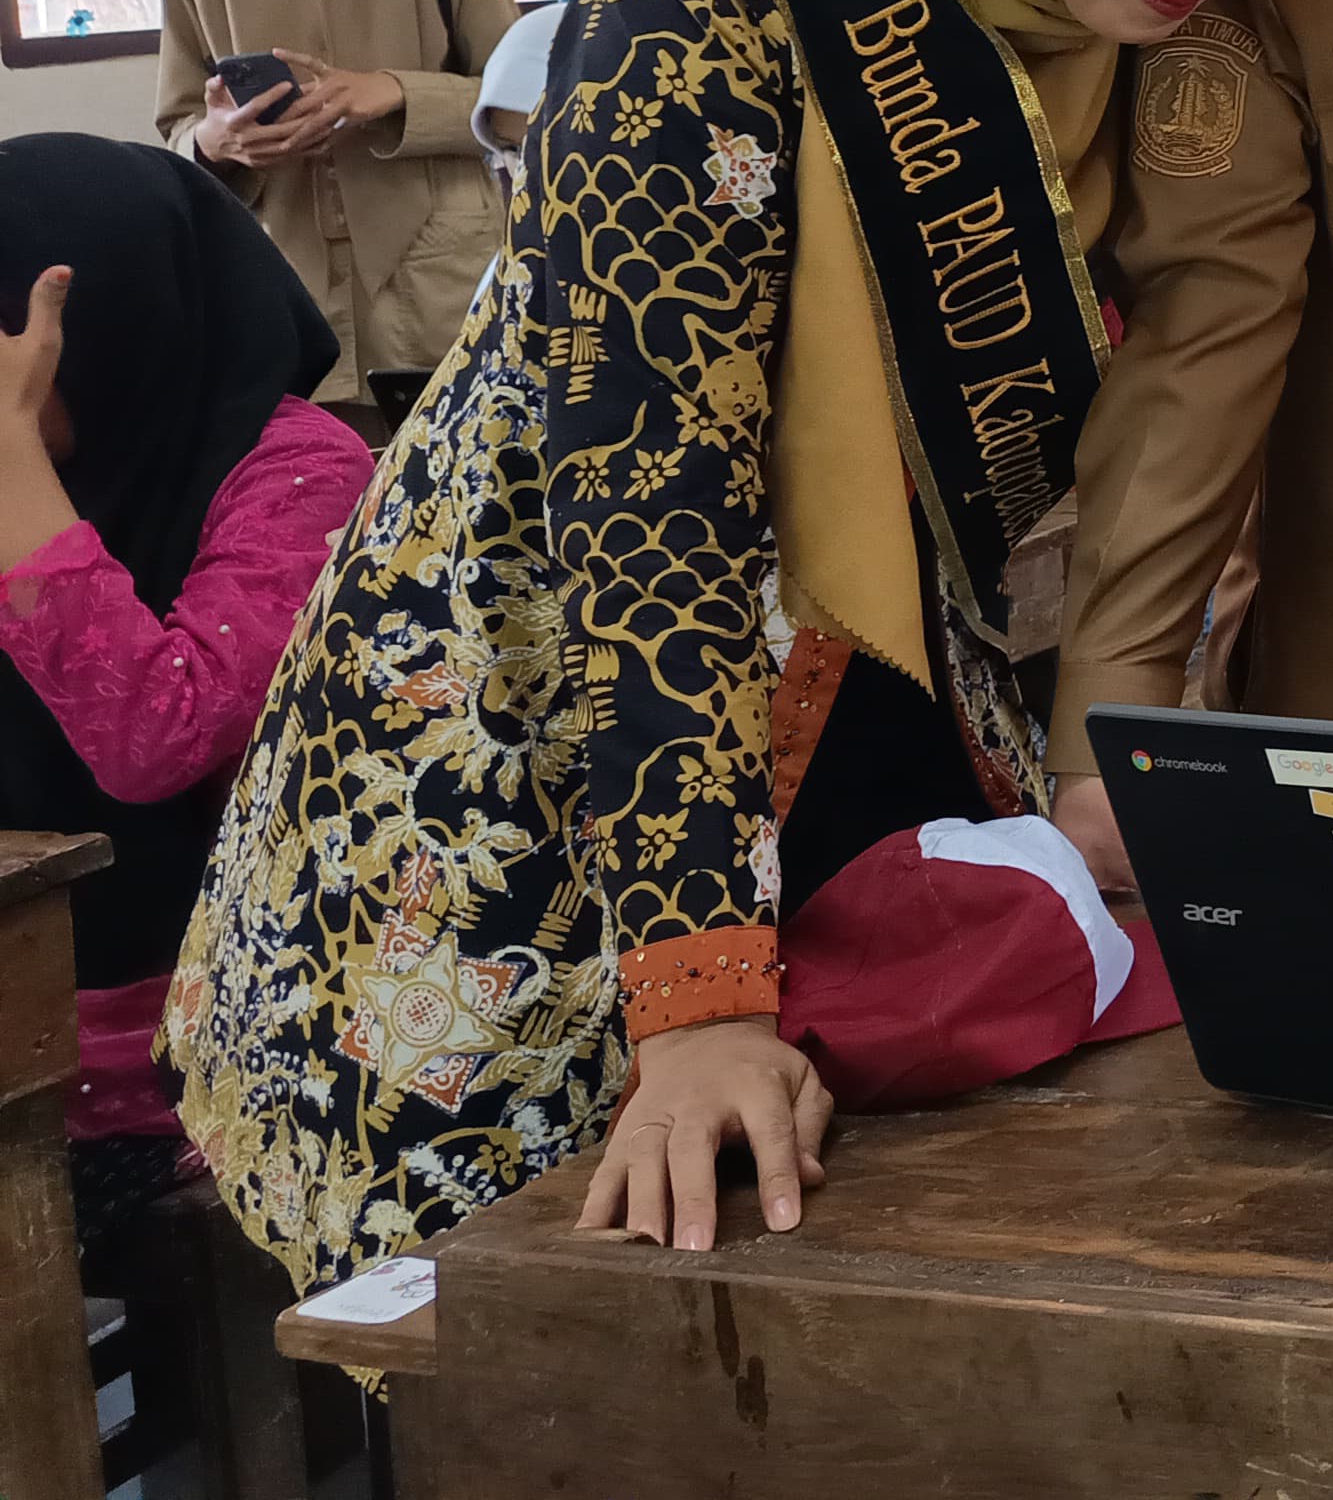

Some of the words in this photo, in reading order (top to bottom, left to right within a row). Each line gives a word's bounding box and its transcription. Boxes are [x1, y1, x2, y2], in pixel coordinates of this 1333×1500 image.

[1200, 18, 1259, 56] TIMUR
[916, 186, 1033, 350] PAUD
[1154, 756, 1228, 774] chromebook
[1182, 903, 1243, 927] acer
